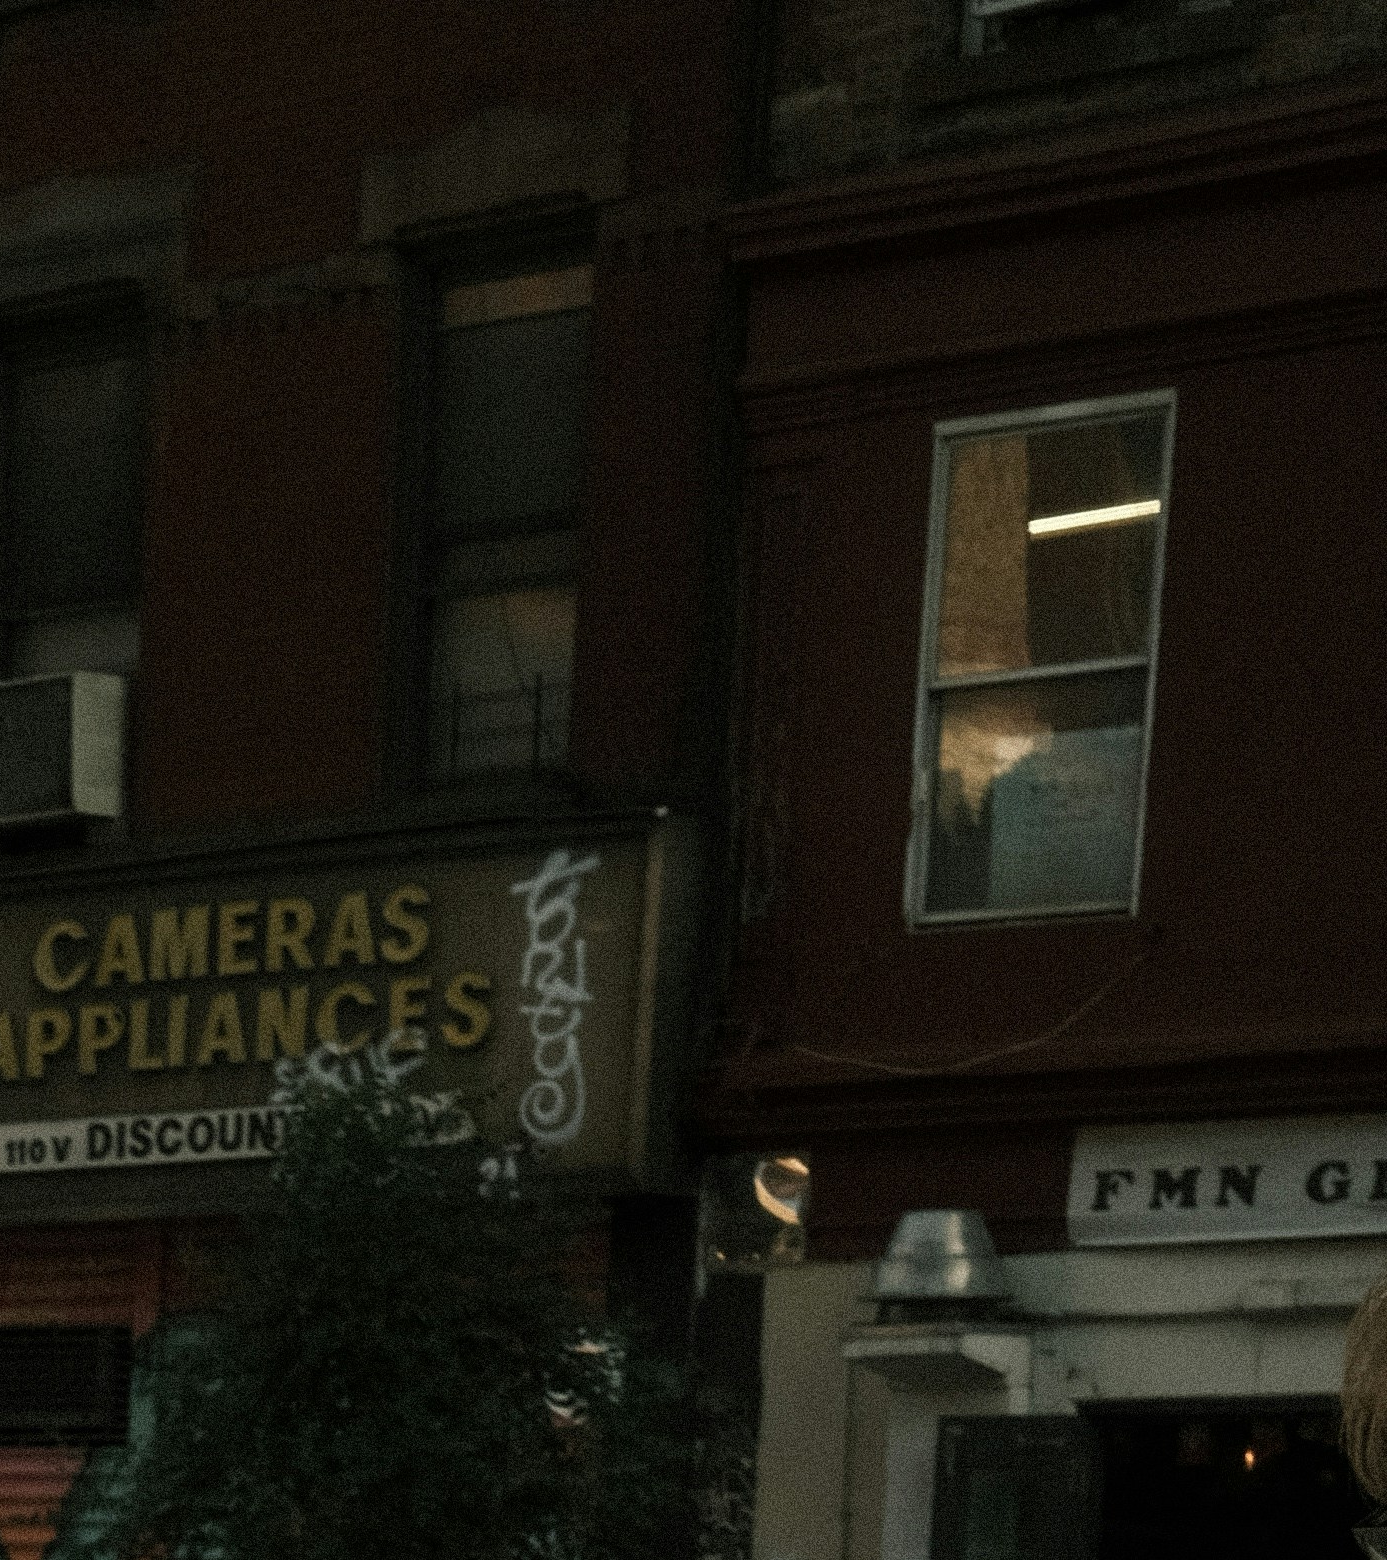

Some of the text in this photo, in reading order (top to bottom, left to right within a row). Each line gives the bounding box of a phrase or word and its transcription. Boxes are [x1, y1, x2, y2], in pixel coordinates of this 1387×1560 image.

[30, 886, 430, 994] CAMERAS
[5, 1140, 45, 1165] 110
[53, 1136, 73, 1161] V
[1091, 1164, 1261, 1210] FMN
